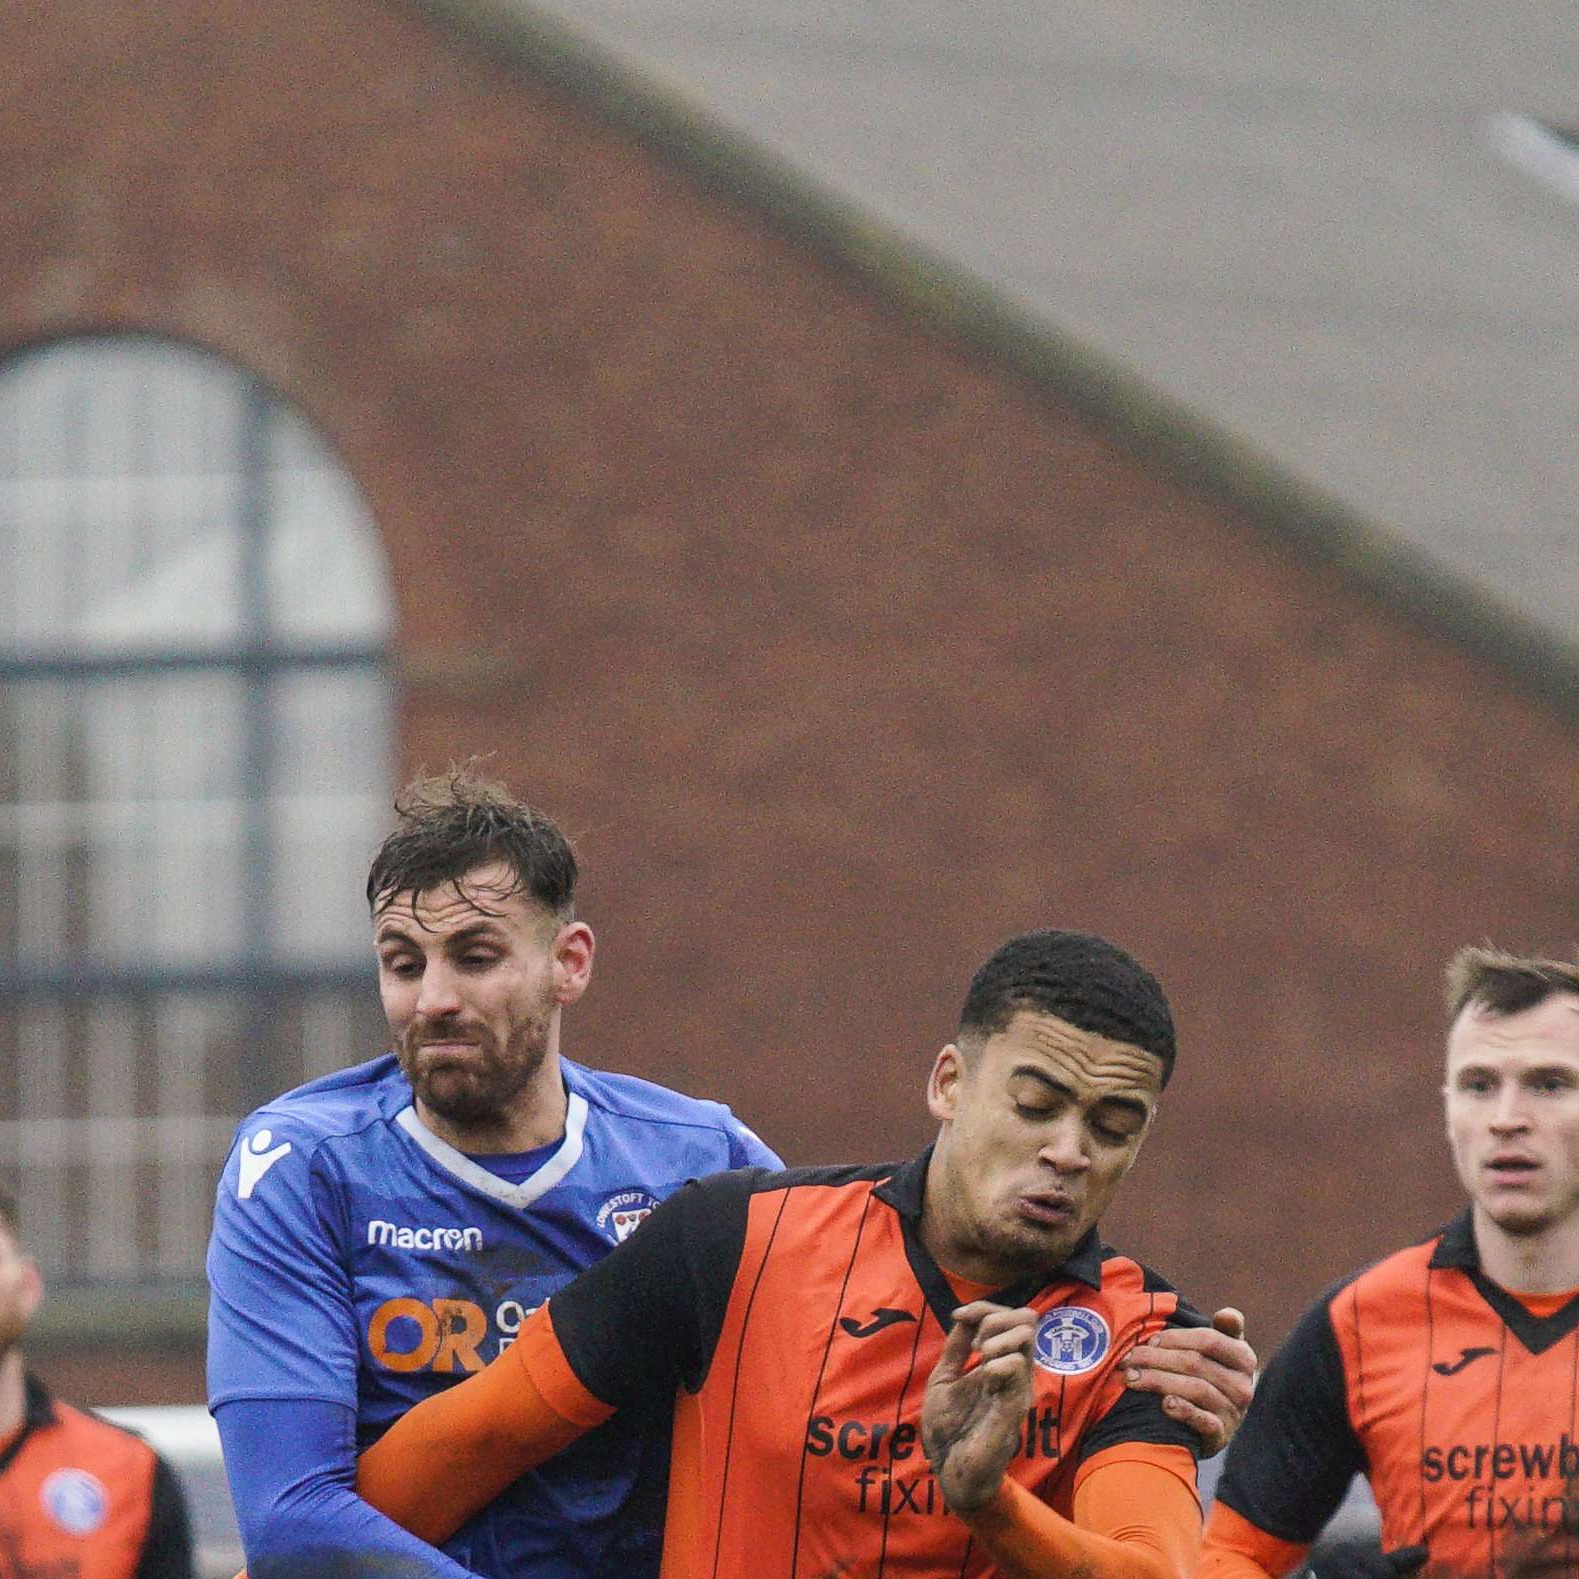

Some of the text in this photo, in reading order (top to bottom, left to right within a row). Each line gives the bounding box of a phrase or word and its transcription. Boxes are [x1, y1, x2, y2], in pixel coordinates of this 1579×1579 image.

[368, 1219, 483, 1251] macron
[367, 1298, 488, 1372] OR
[806, 1405, 1061, 1462] screlt
